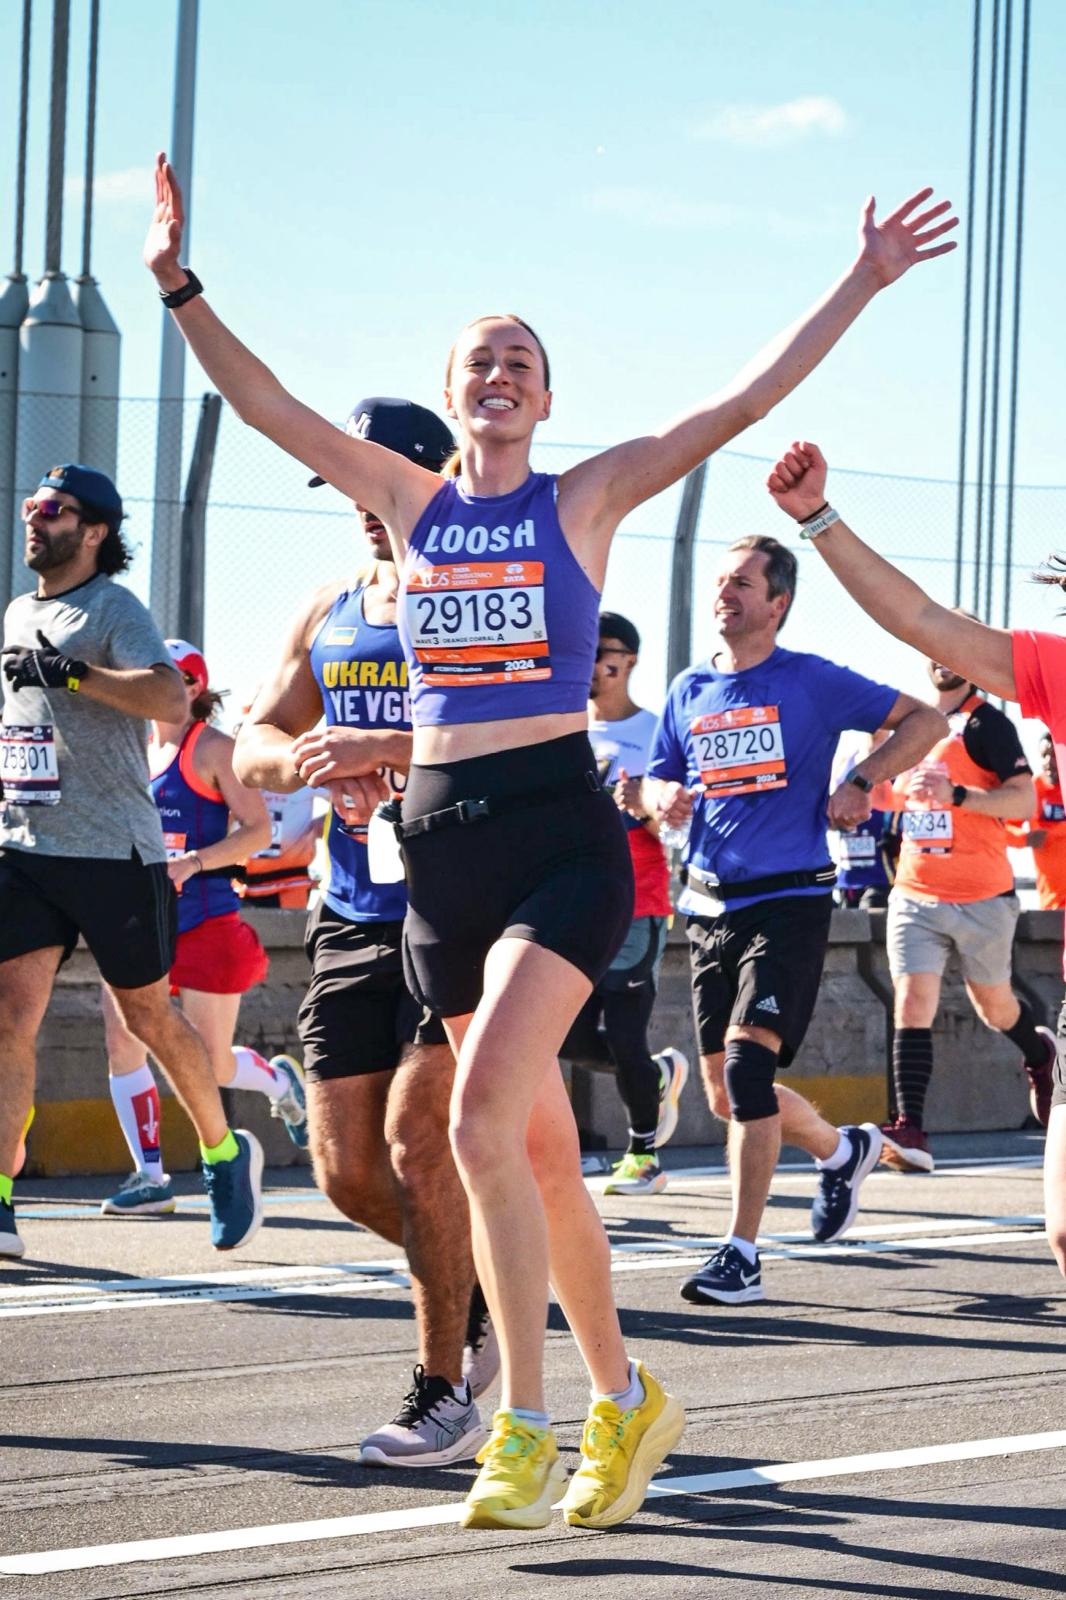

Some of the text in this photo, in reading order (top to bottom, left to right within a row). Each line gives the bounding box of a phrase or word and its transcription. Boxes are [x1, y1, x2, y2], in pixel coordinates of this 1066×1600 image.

[423, 519, 536, 555] LOOSH
[417, 591, 532, 635] 29183
[433, 637, 440, 645] 3
[497, 633, 505, 642] A
[504, 659, 535, 671] 2024
[700, 727, 775, 761] 28720
